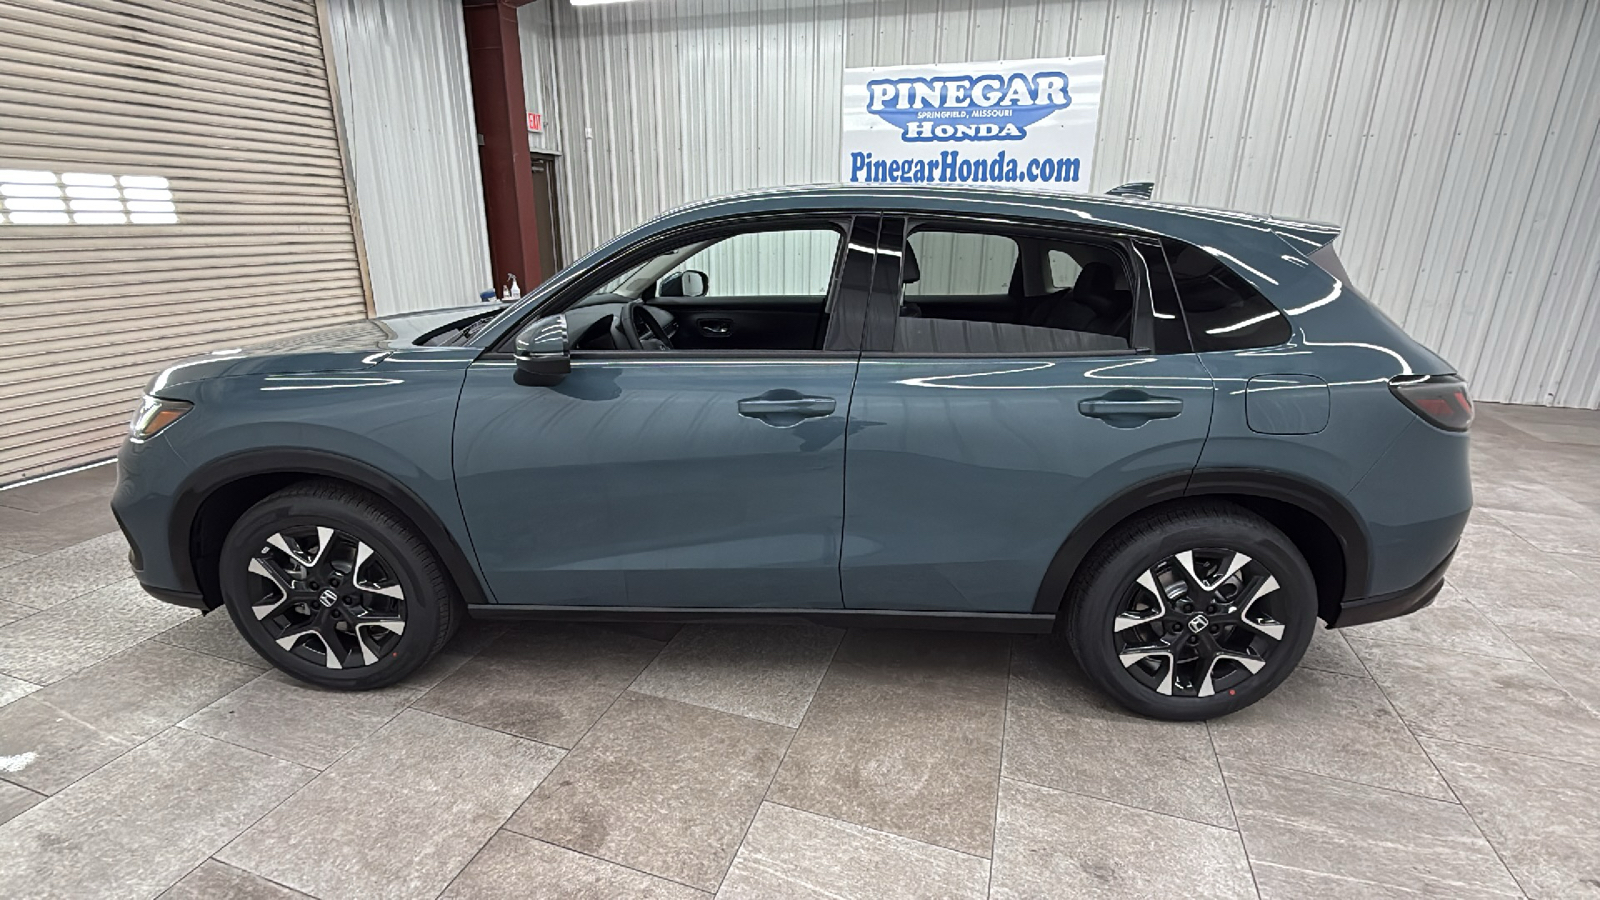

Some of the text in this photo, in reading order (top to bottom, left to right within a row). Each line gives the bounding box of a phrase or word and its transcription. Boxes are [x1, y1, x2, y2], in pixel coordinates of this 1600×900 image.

[871, 76, 1068, 111] PINEGAR
[917, 109, 1013, 119] SPRINGFIELD, MISSOURI
[905, 121, 1022, 138] HONDA
[849, 150, 1081, 183] PinegarHonda.com
